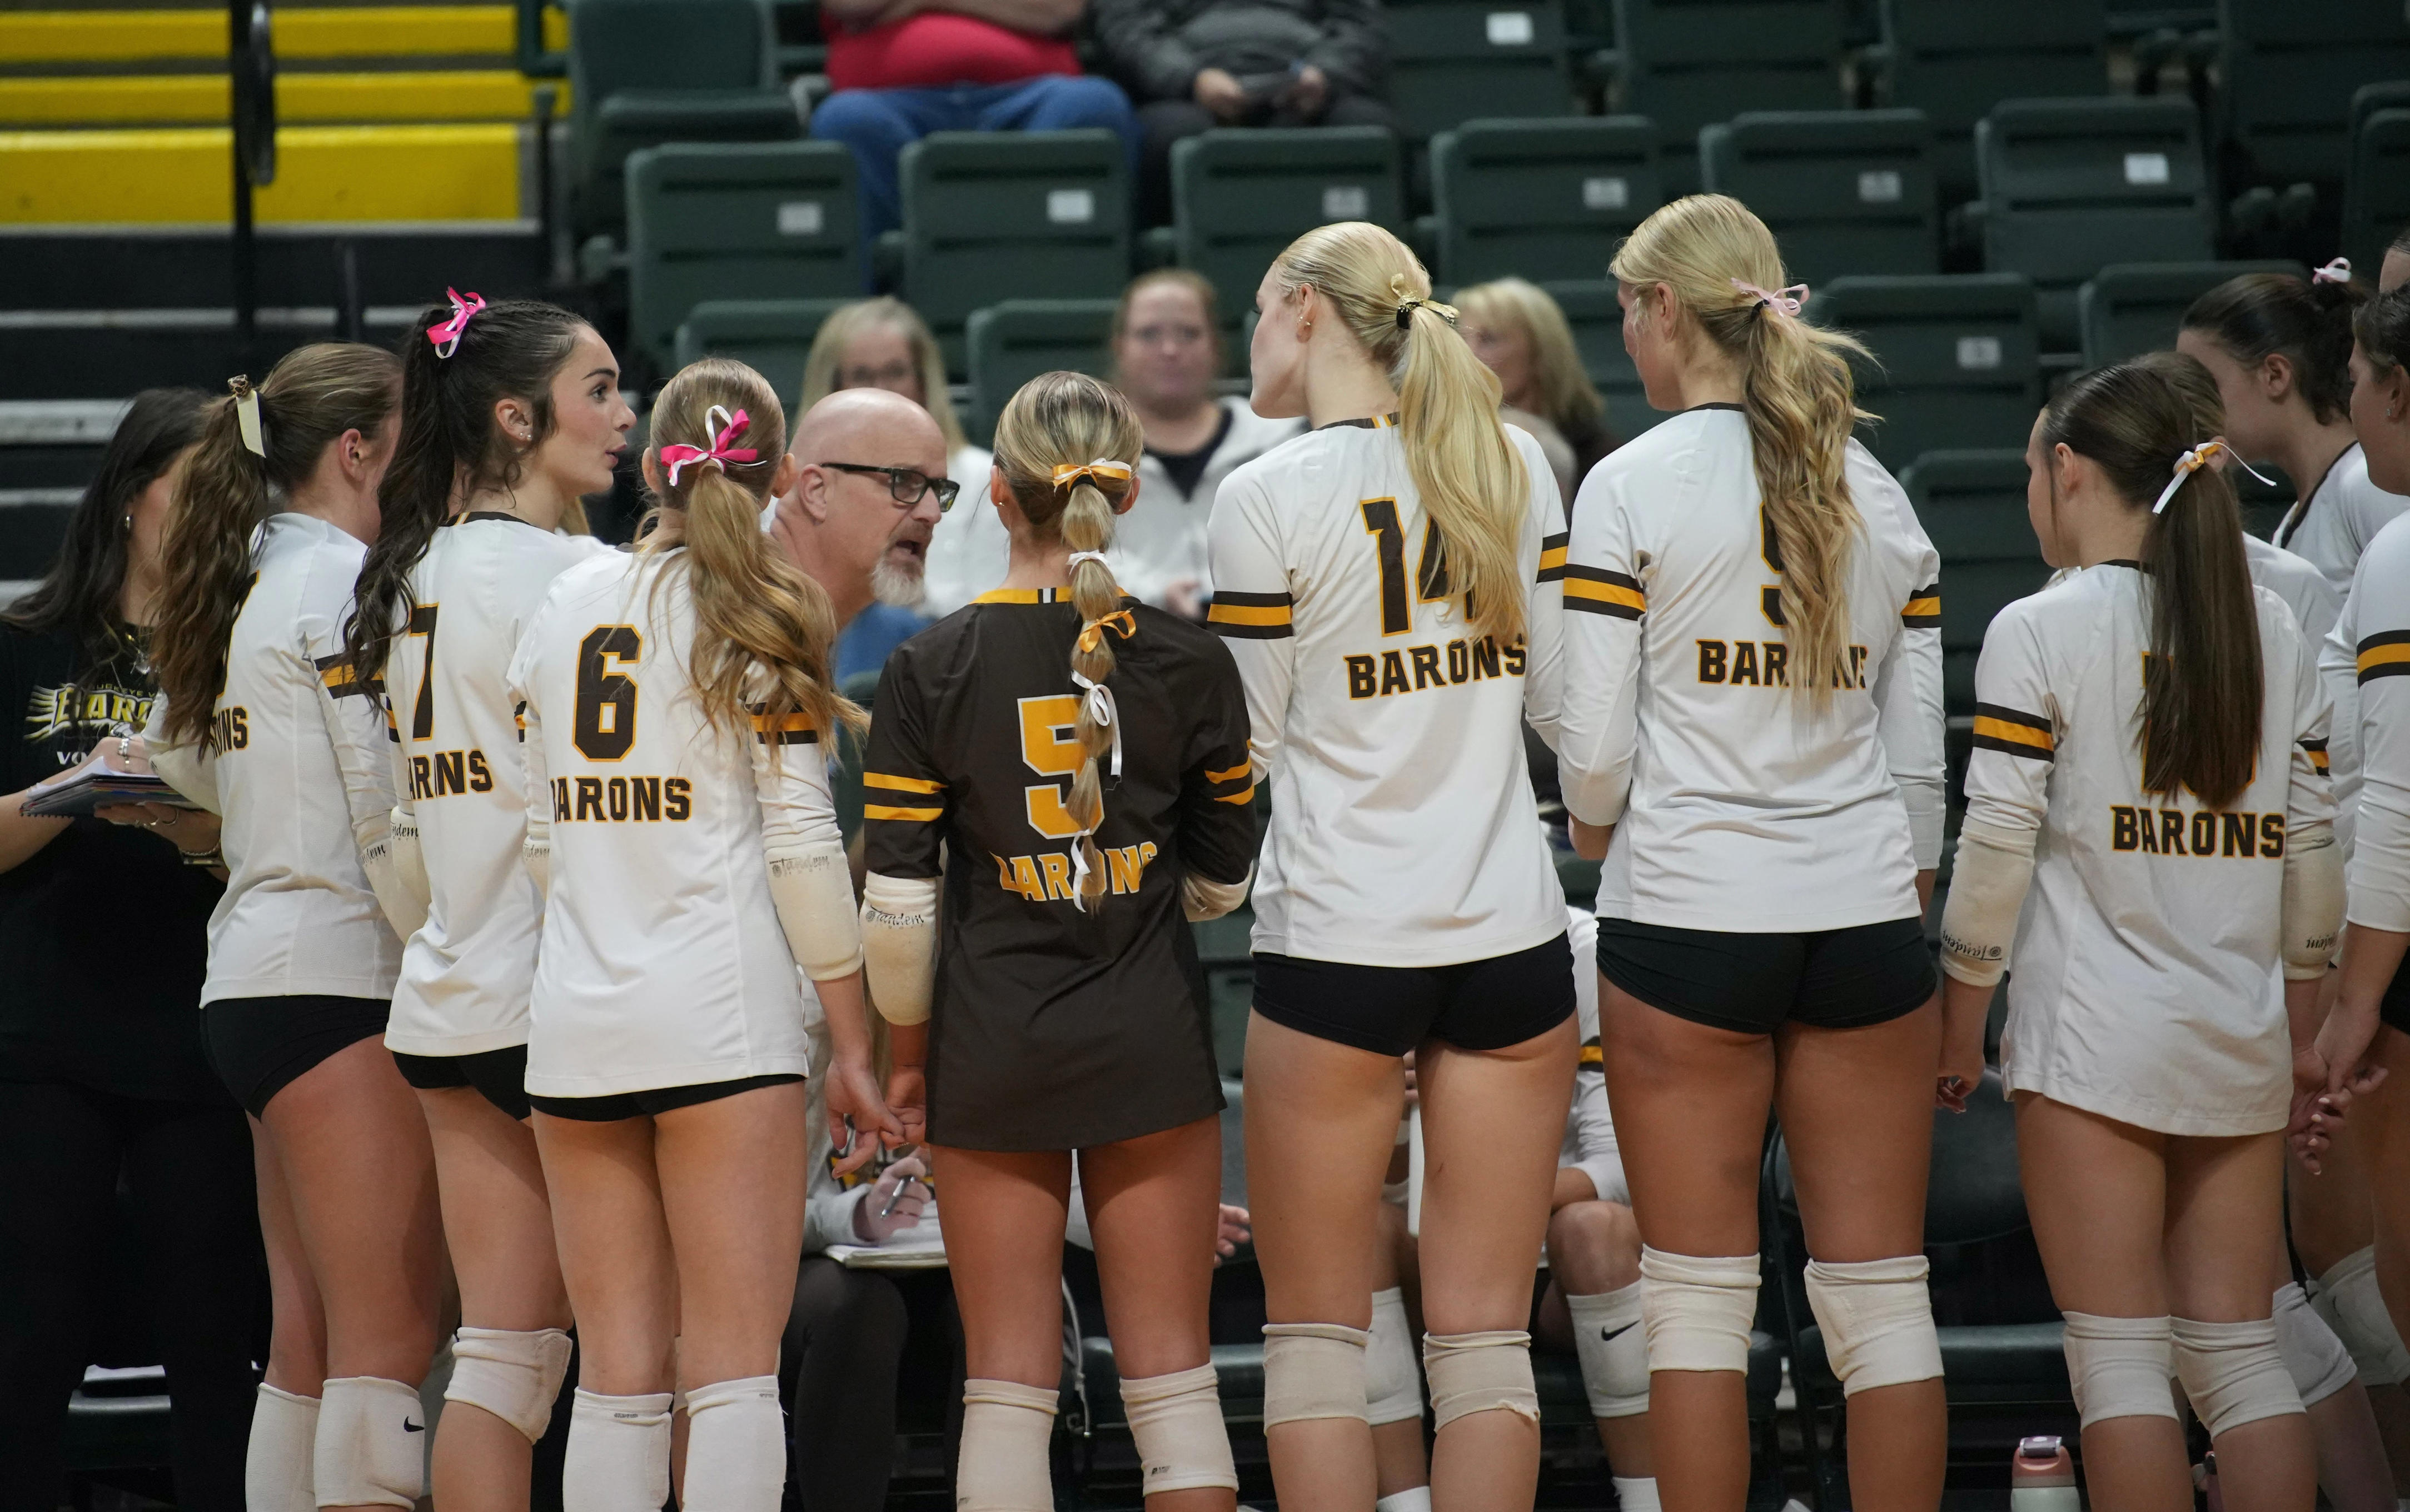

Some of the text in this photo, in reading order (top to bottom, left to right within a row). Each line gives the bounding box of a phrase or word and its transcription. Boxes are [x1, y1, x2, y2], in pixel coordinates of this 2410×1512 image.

[408, 601, 440, 742] 7
[571, 624, 644, 762] 6
[1343, 633, 1527, 700] BARONS
[550, 776, 692, 824] ARONS
[1017, 693, 1104, 840] 5
[2110, 805, 2285, 860] BARONS
